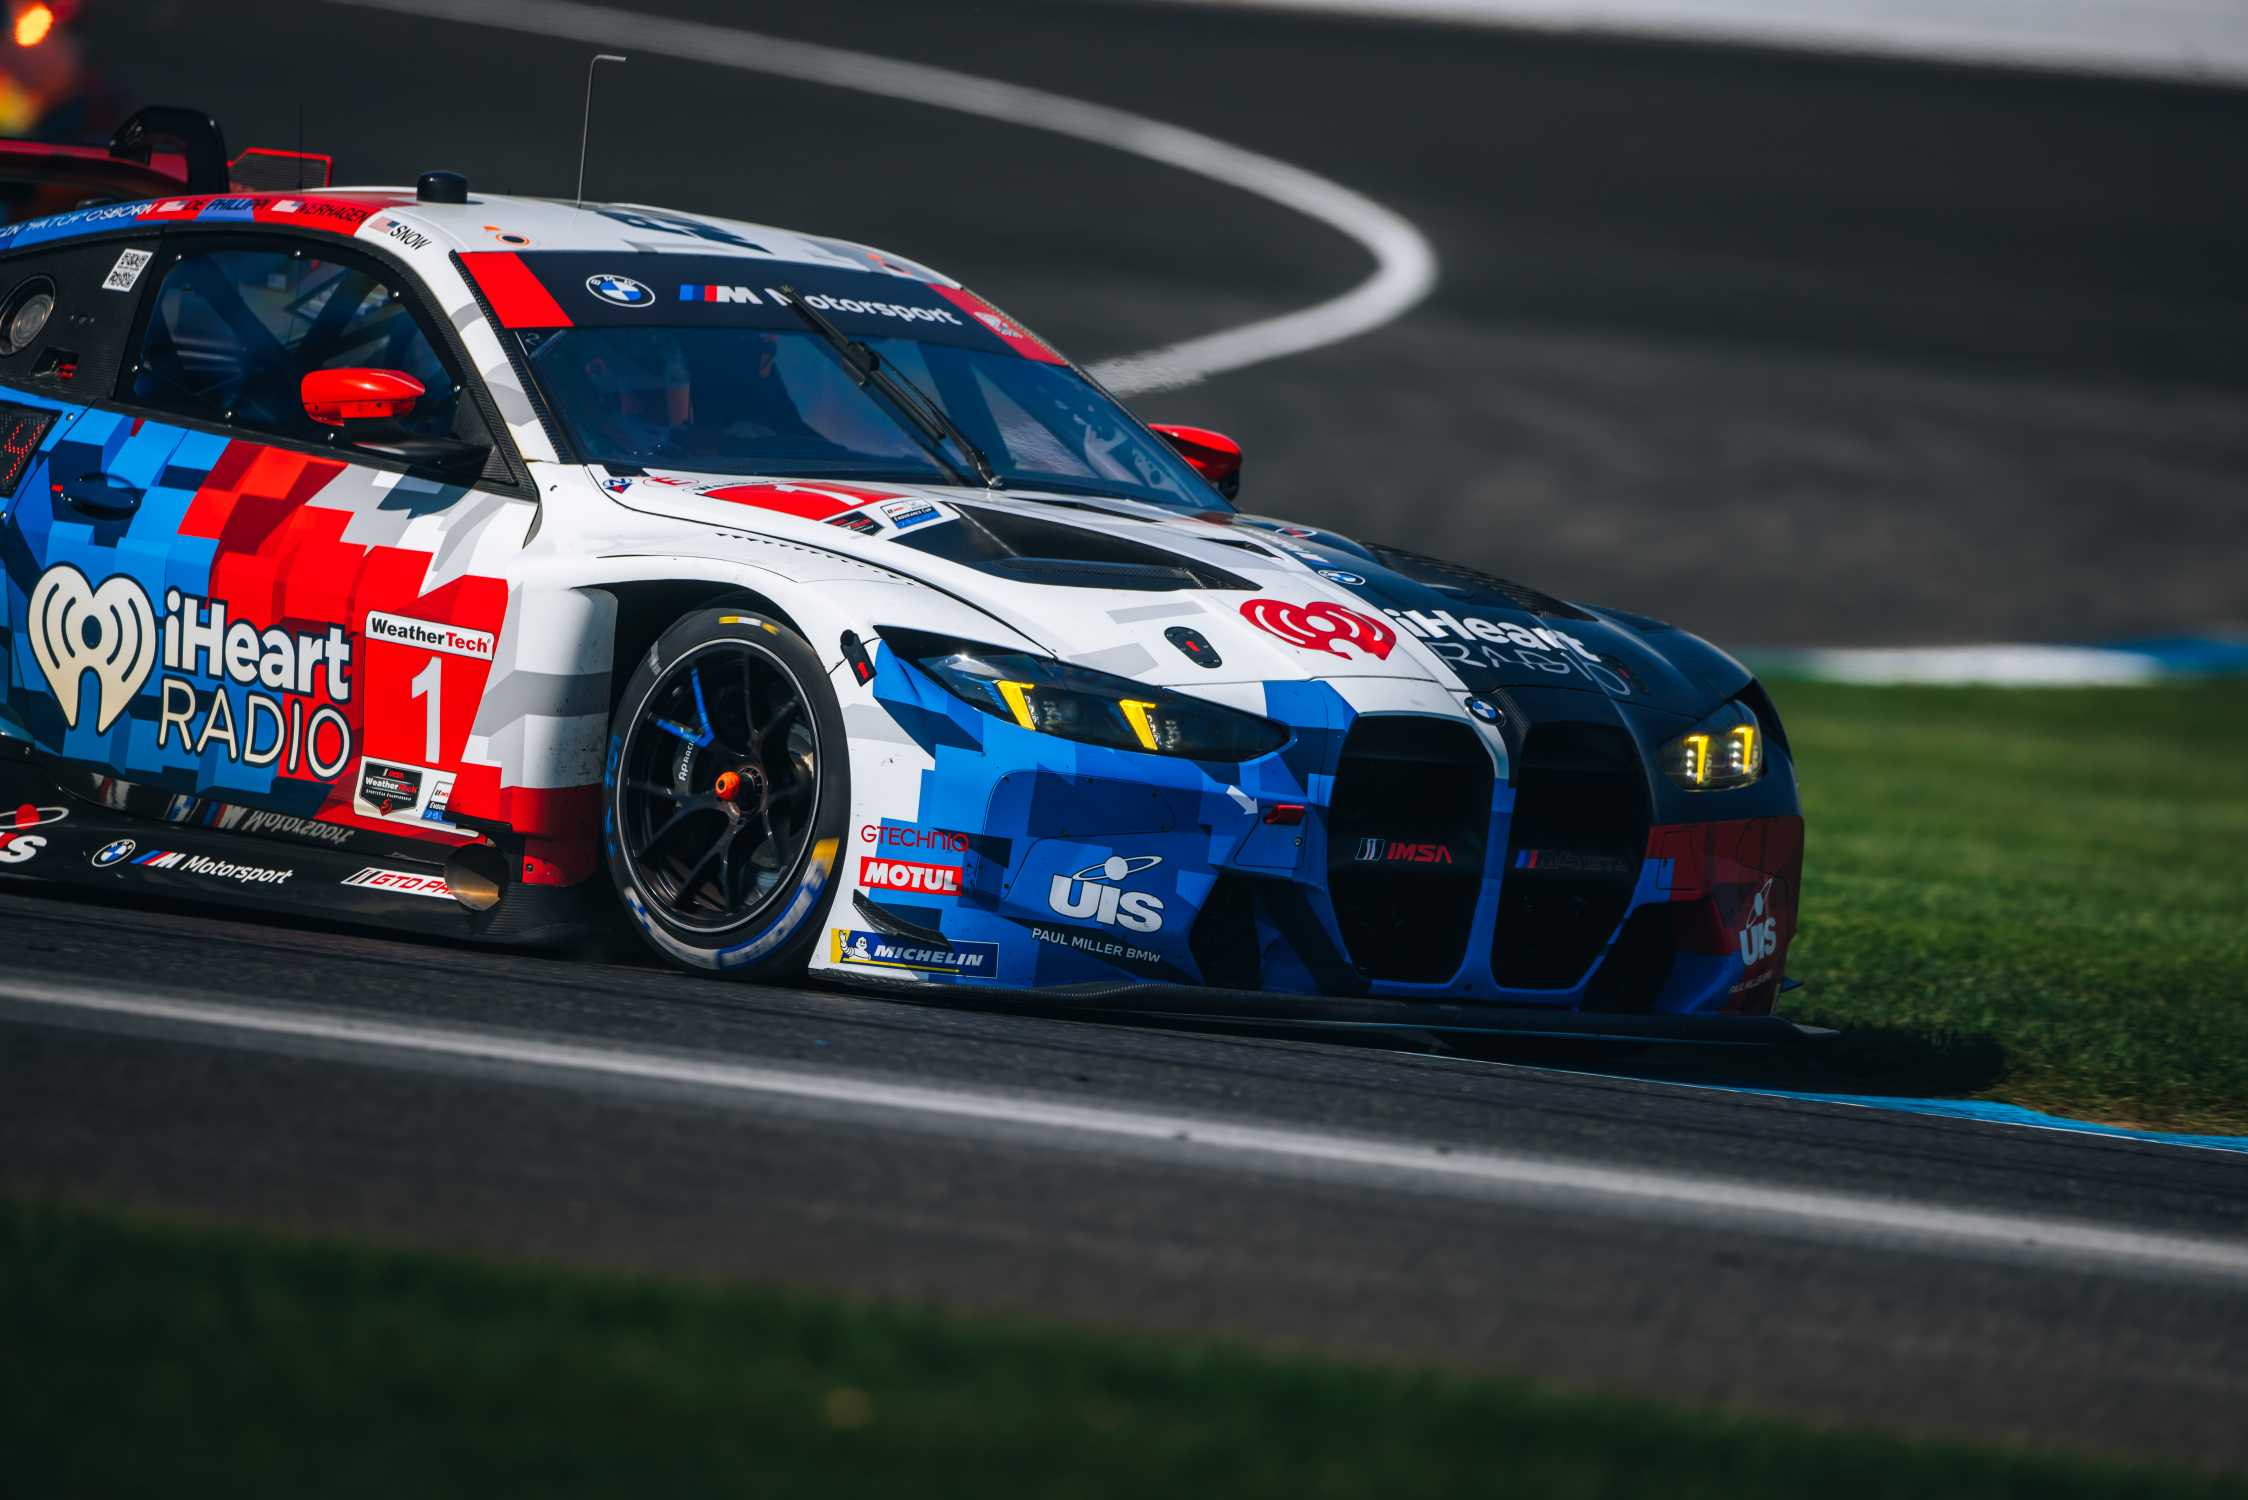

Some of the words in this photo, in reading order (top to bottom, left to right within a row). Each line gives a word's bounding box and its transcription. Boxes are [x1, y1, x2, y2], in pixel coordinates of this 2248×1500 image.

[390, 225, 432, 251] SNOW
[164, 590, 351, 701] iHeart
[371, 617, 489, 653] WeatherTech
[1383, 608, 1602, 663] iHeart
[1424, 641, 1631, 696] RADIO
[411, 656, 442, 765] 1
[159, 680, 351, 778] RADIO
[861, 824, 970, 852] GTECHNIQ
[1387, 841, 1453, 865] IMSA
[180, 855, 295, 884] Motorsport
[370, 873, 423, 889] GTD
[863, 861, 959, 892] MOTUL
[1048, 873, 1165, 933] UIS
[873, 944, 985, 967] MICHELIN
[1031, 927, 1069, 948] PAUL
[1070, 934, 1124, 958] MILLER
[1125, 945, 1161, 964] BMW
